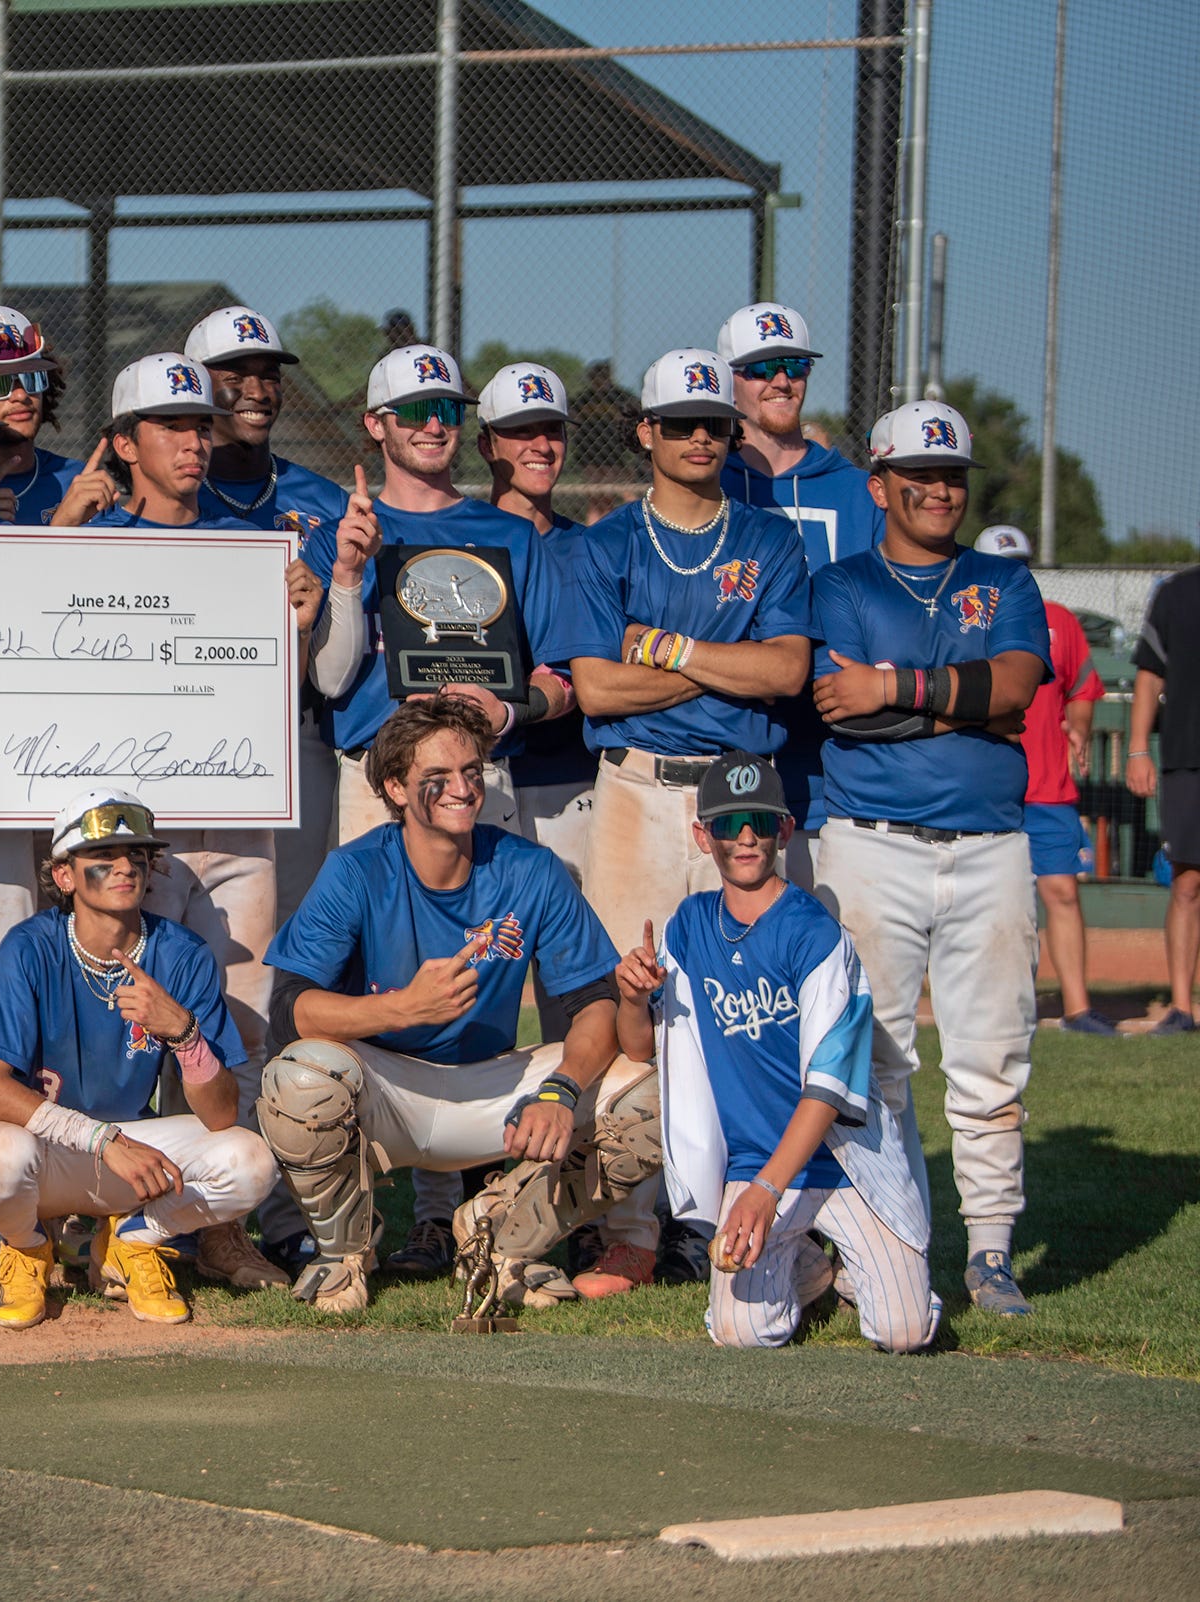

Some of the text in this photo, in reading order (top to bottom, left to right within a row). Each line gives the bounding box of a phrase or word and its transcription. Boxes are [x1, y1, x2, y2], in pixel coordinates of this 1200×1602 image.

[68, 594, 170, 610] June 24, 2023
[170, 617, 195, 626] DATE
[436, 622, 477, 631] CHAMPIONS
[159, 639, 258, 665] $ 2,000.00
[425, 674, 490, 682] CHAMPIONS
[173, 685, 215, 694] DOLLARS
[725, 763, 760, 796] W
[703, 976, 801, 1040] Royls
